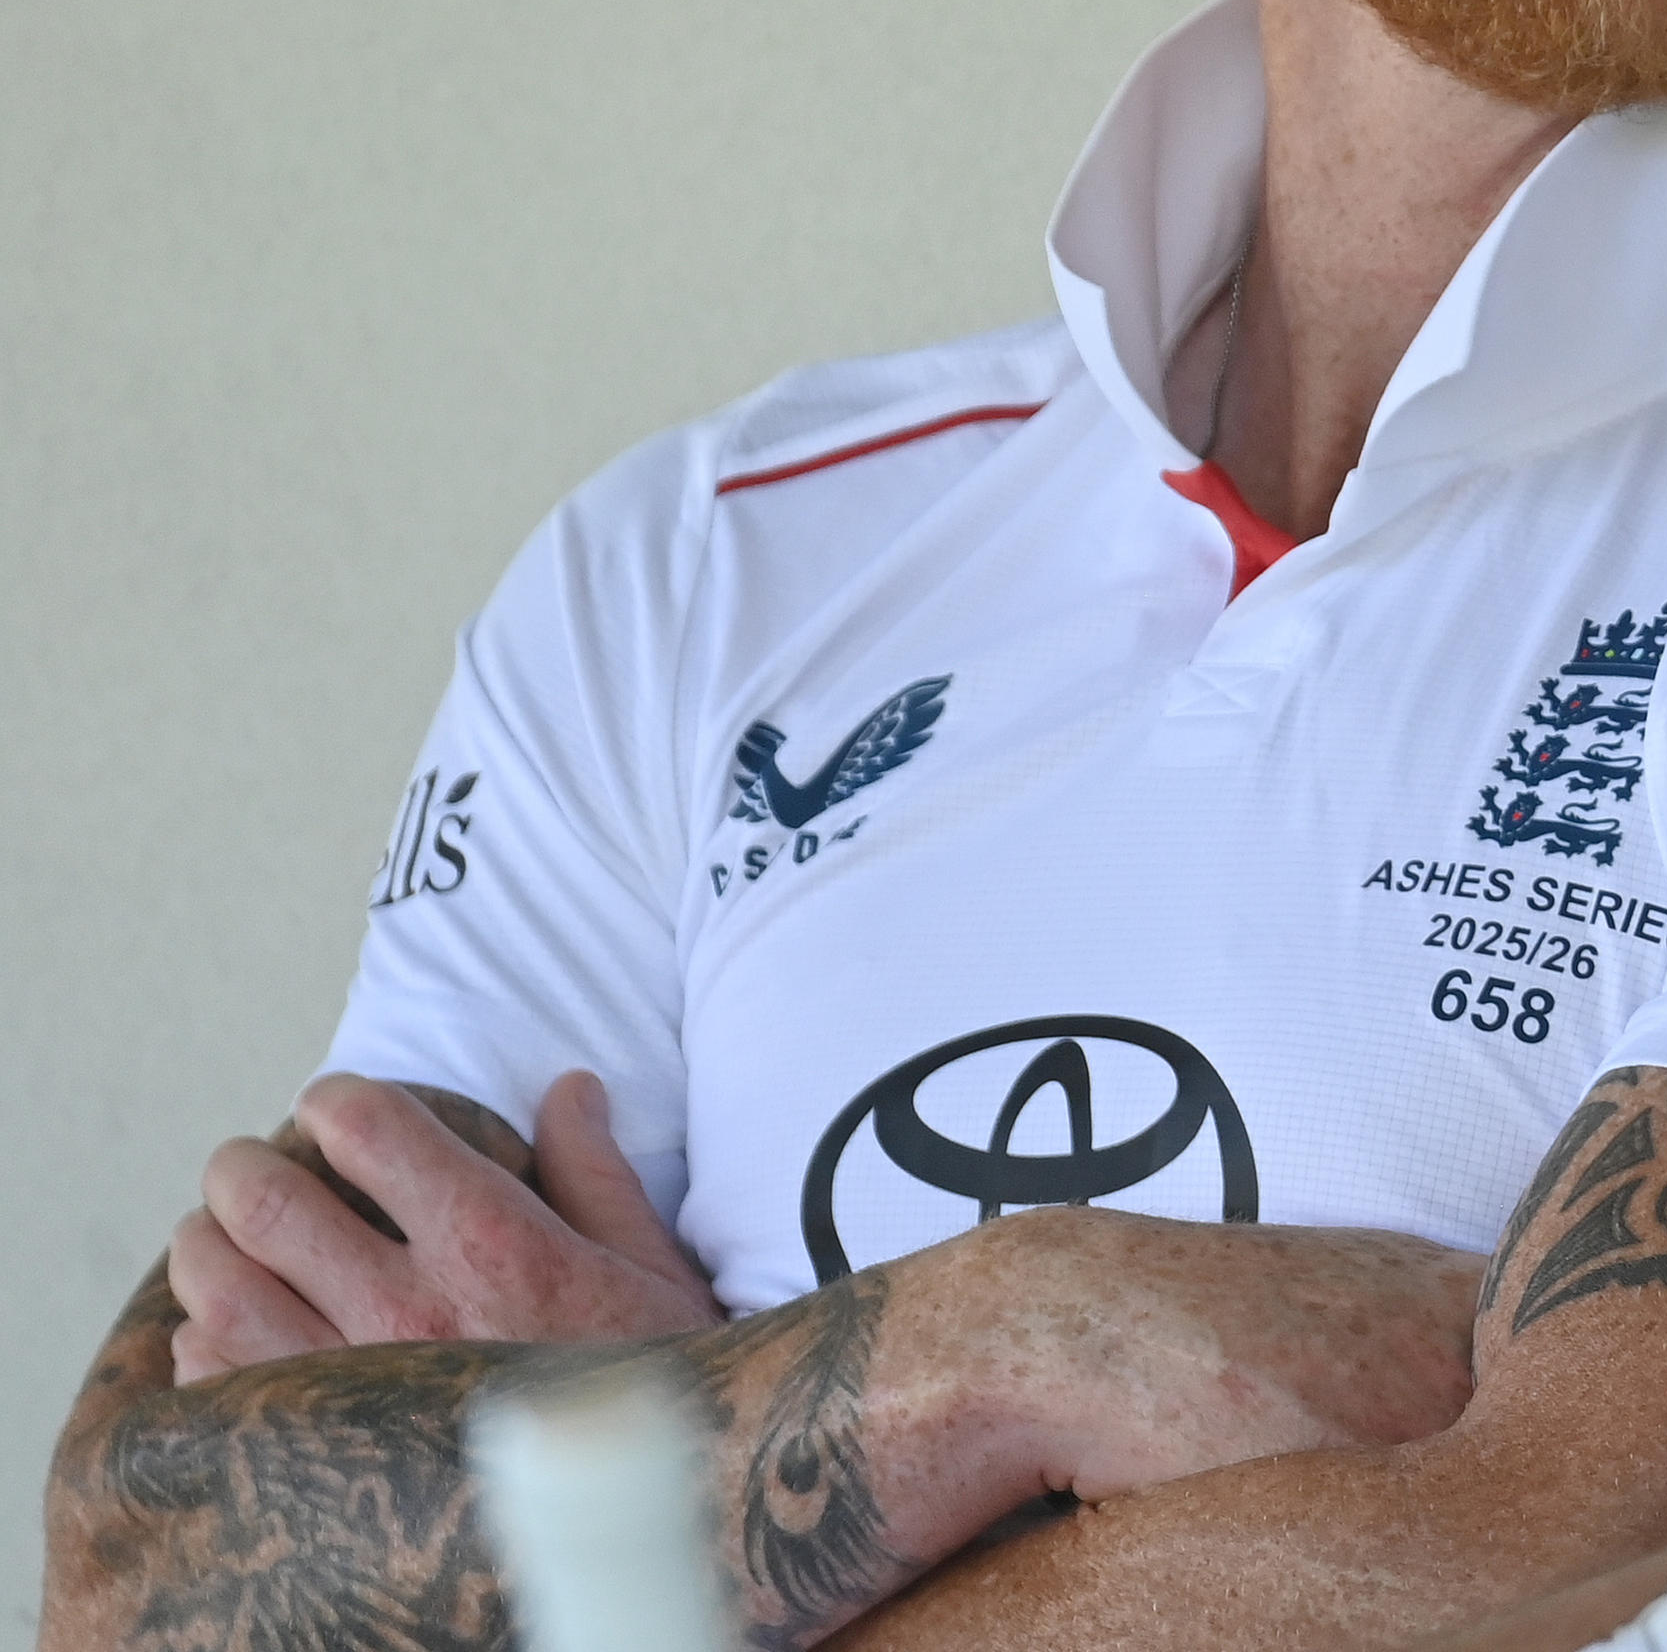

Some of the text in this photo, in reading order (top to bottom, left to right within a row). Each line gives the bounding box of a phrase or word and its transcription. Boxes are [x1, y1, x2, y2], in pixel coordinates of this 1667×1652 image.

[1361, 859, 1515, 903] ASHES
[1423, 913, 1599, 980] 2025/26
[1430, 968, 1555, 1044] 658
